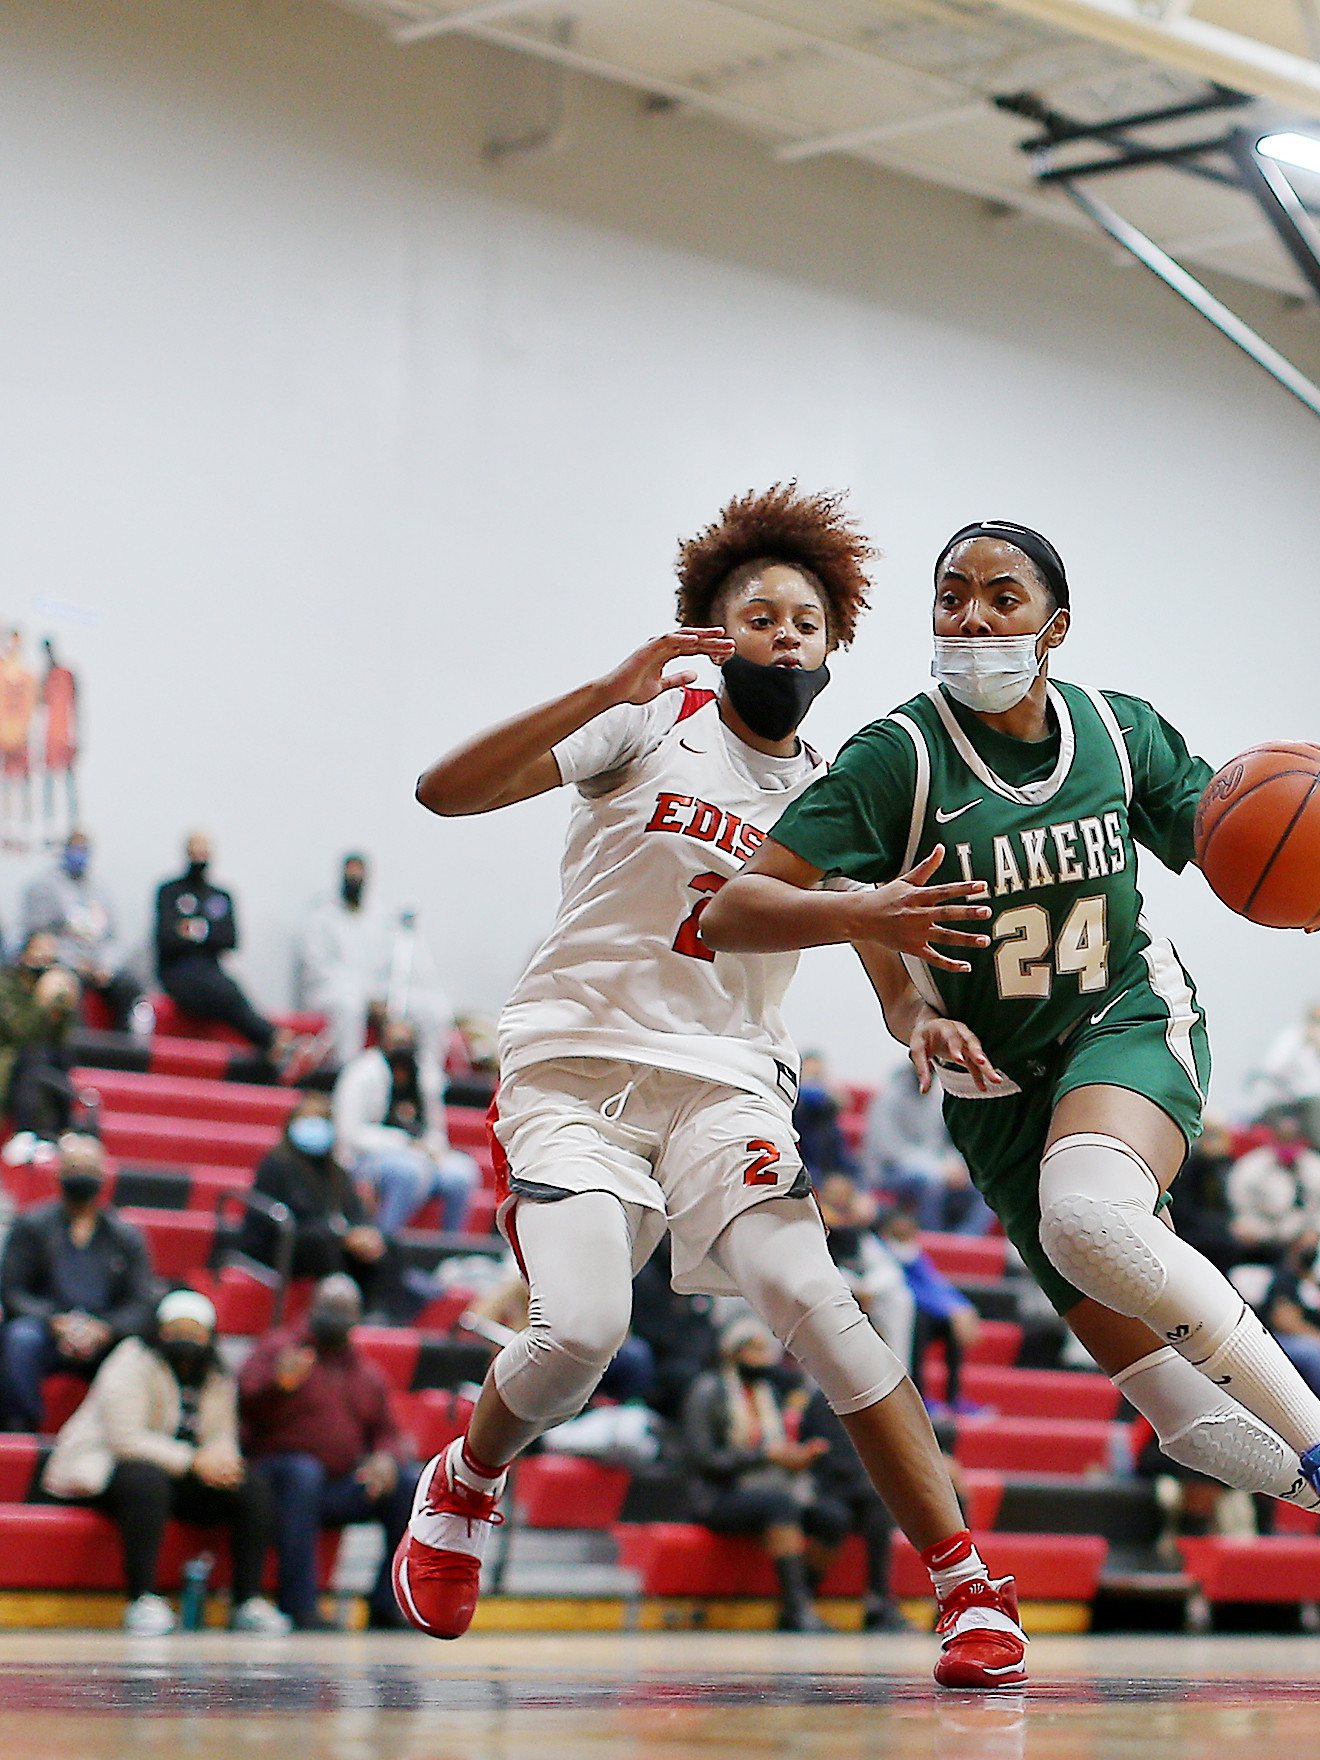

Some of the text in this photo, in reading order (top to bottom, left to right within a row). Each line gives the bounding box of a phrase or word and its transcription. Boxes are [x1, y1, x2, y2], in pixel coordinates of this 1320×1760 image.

[644, 792, 769, 861] EDIS
[955, 812, 1126, 901] LAKERS
[993, 893, 1110, 1000] 24
[743, 1139, 780, 1186] 2
